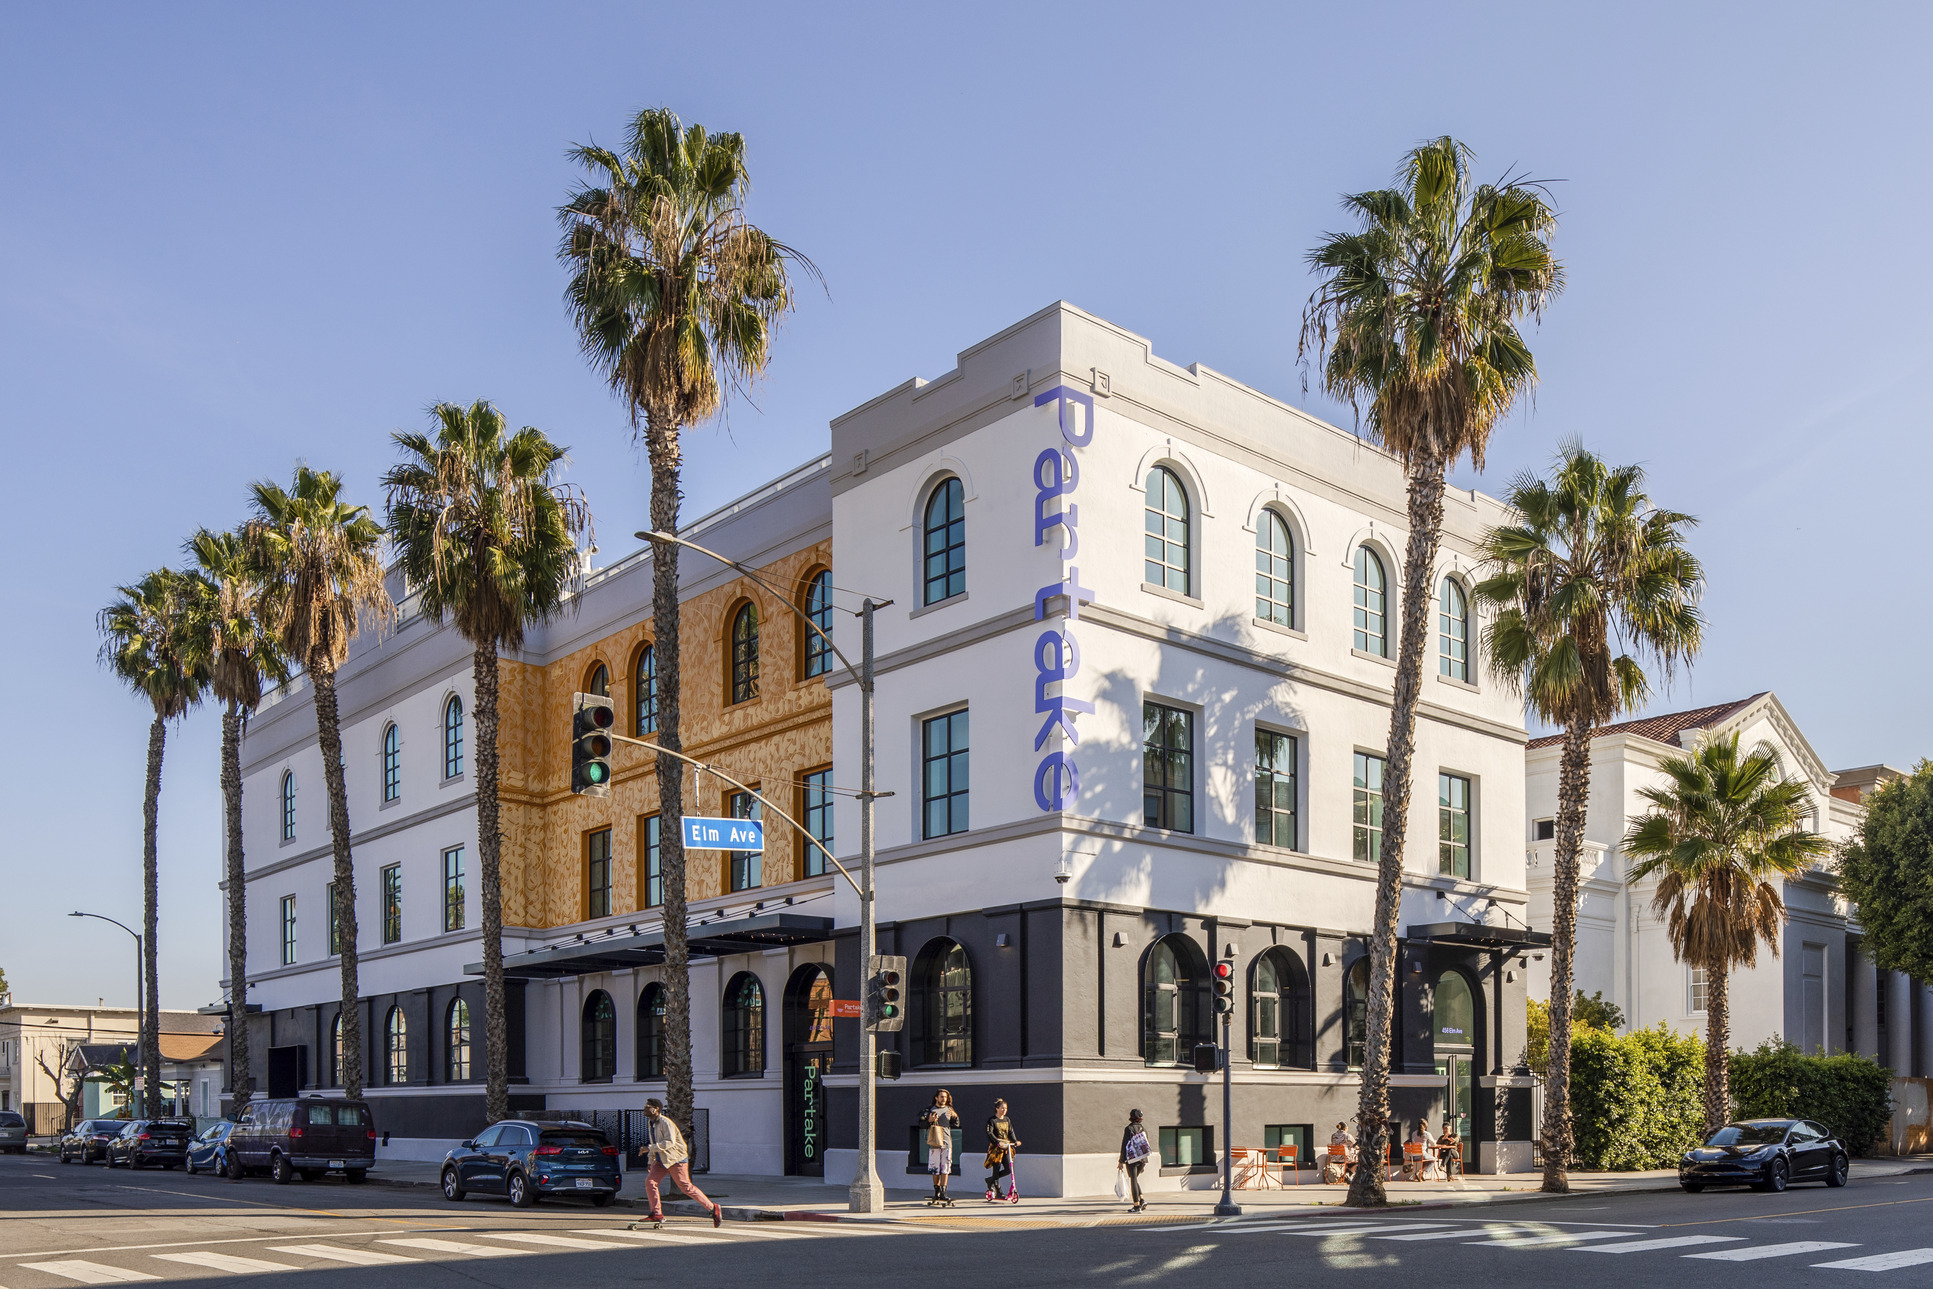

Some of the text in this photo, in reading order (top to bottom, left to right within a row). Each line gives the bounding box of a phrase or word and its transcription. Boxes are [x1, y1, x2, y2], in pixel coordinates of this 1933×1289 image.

[1034, 385, 1095, 812] Partake
[692, 825, 755, 843] Elm Ave
[804, 1066, 816, 1158] Partake
